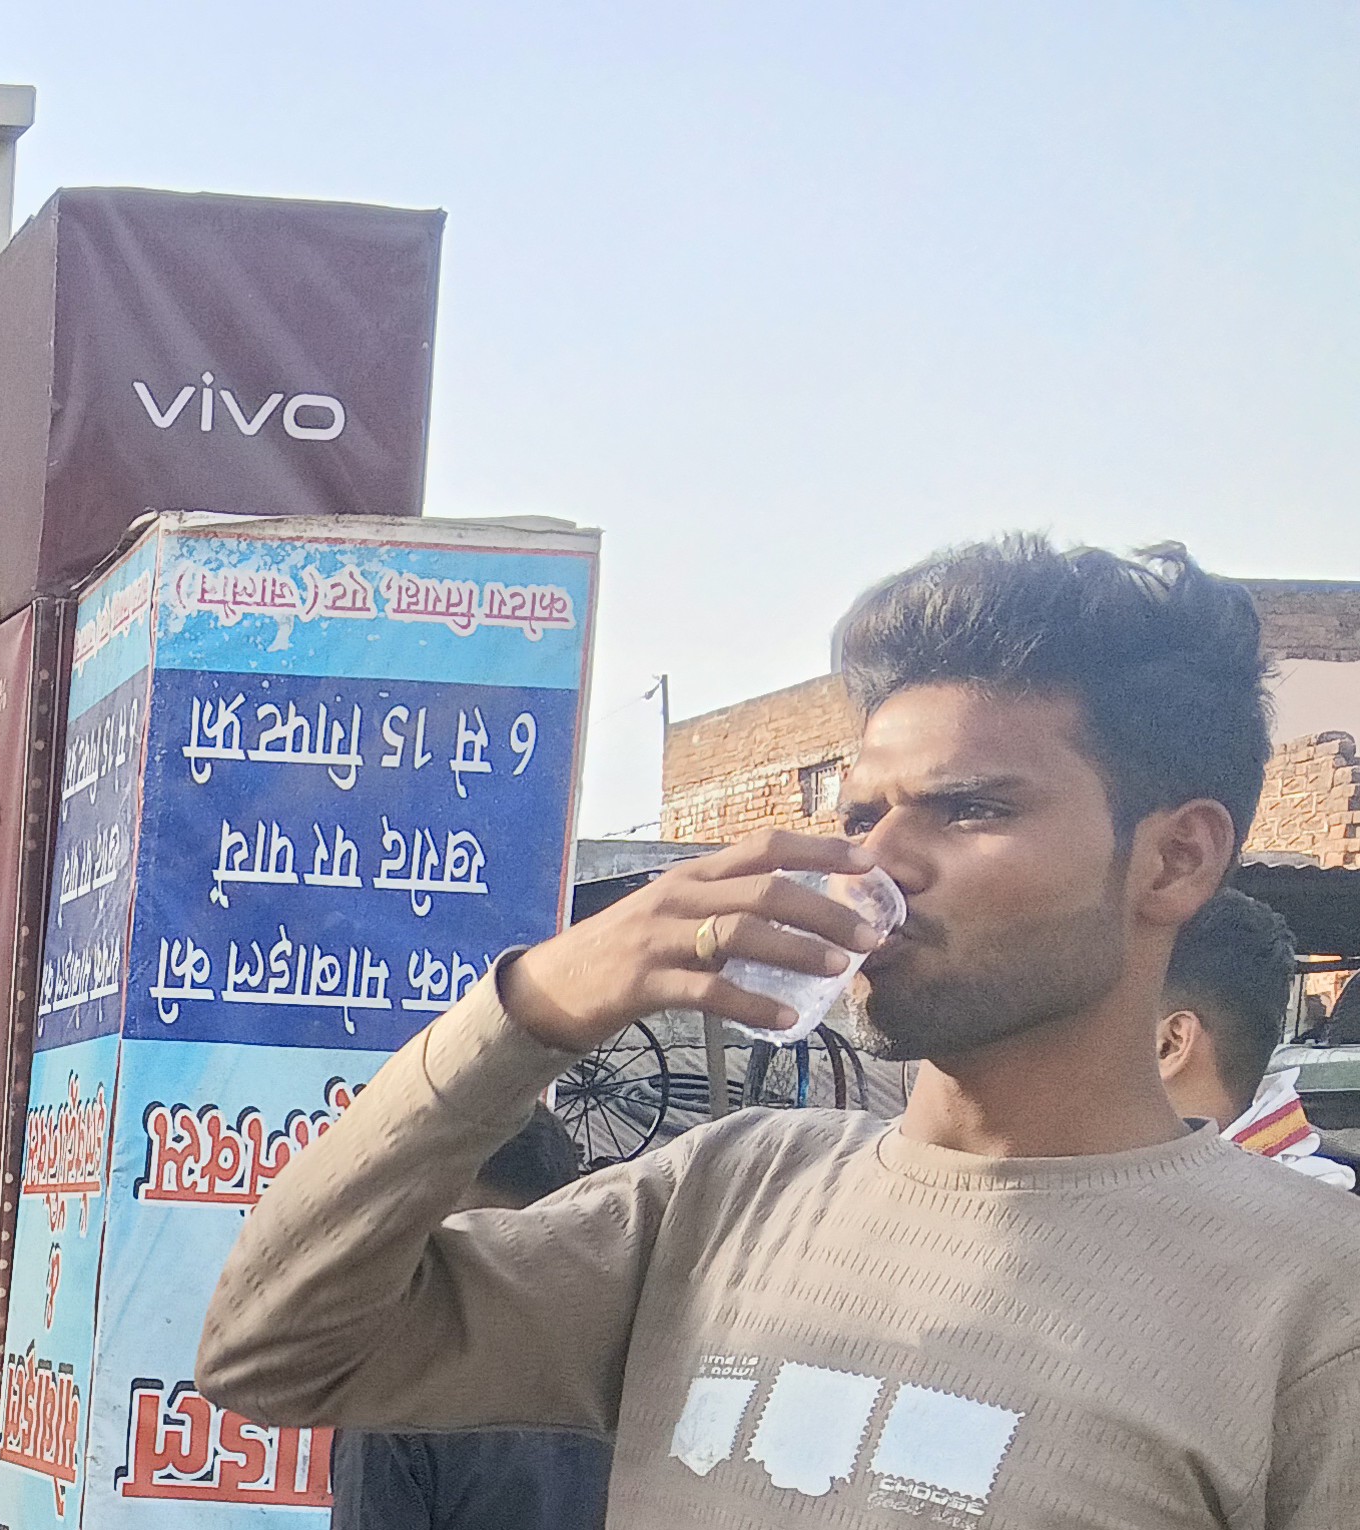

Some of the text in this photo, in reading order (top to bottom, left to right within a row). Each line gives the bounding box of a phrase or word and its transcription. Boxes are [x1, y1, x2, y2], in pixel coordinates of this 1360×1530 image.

[132, 371, 346, 442] vivo
[182, 695, 536, 796] फ्री गिफ्ट 15 से 6
[212, 816, 488, 915] पायें पर खरीद
[150, 925, 391, 1034] की मोबाइल
